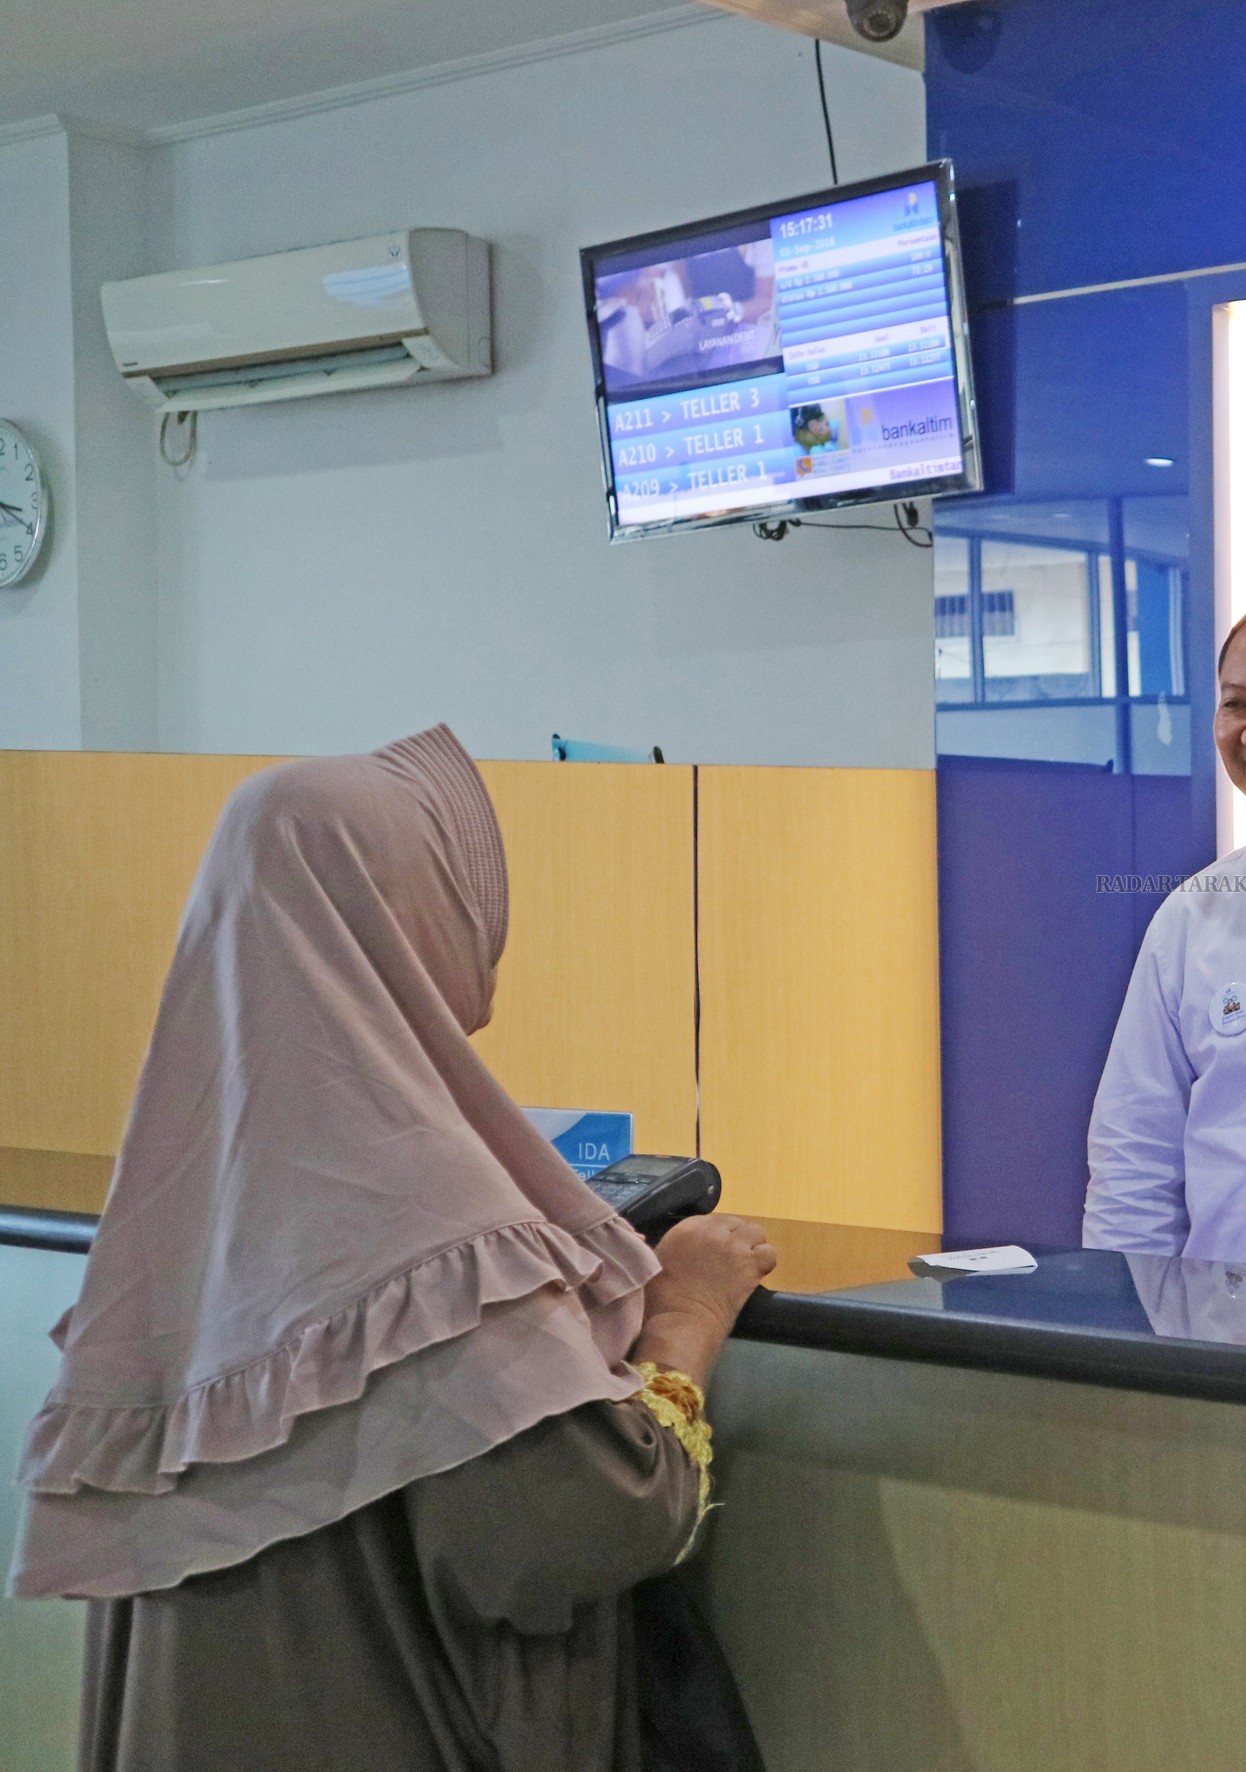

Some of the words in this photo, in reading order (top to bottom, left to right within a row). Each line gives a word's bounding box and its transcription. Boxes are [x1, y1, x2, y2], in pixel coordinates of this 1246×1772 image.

[780, 213, 833, 239] 15:17:31
[615, 408, 653, 432] A211
[680, 391, 741, 420] TELLER
[750, 387, 760, 408] 3
[881, 415, 953, 441] bankaltim
[618, 443, 656, 467] A210
[684, 428, 744, 456] TELLER
[754, 424, 764, 444] 1
[24, 463, 34, 481] 2
[622, 479, 660, 501] A209
[688, 464, 748, 491] TELLER
[757, 460, 768, 480] 1
[14, 545, 23, 563] 5
[578, 1142, 610, 1161] IDA
